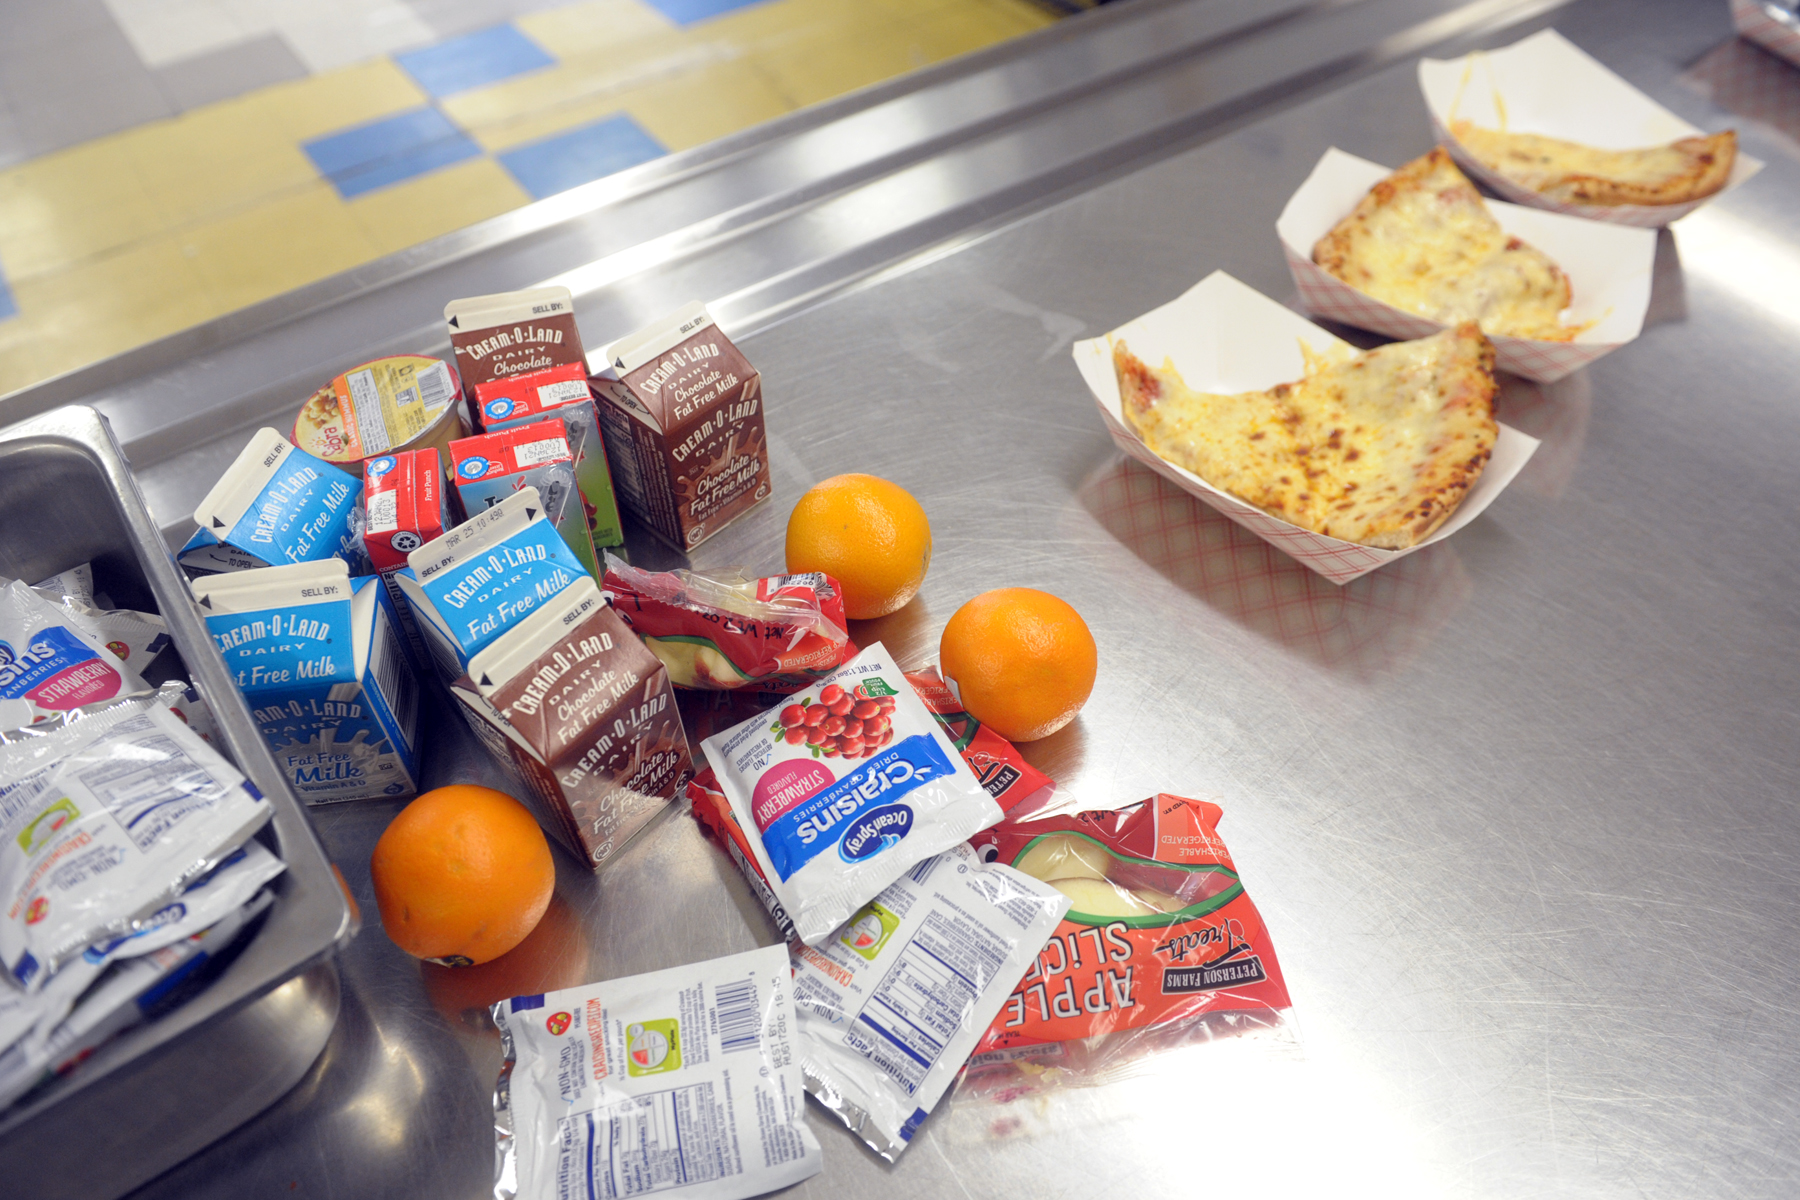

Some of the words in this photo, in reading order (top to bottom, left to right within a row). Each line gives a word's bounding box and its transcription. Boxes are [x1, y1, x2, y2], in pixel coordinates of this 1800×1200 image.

[533, 306, 548, 314] SELL
[680, 322, 694, 333] SELL
[693, 316, 705, 327] BY:
[493, 345, 546, 360] DAIRY
[494, 355, 552, 375] Chocolate
[507, 372, 532, 382] Punch
[668, 361, 709, 390] DAIRY
[674, 369, 722, 402] Chocolate
[339, 394, 353, 423] HUMMUS
[619, 394, 627, 402] TO
[624, 397, 637, 410] OPEN
[673, 399, 695, 420] Fat
[691, 388, 716, 412] Free
[716, 375, 740, 396] Milk
[322, 426, 344, 457] Sabra
[483, 429, 509, 439] Punch
[510, 425, 529, 433] Fruit
[695, 422, 744, 457] DAIRY
[263, 451, 278, 467] SELL
[274, 441, 286, 454] BY:
[690, 493, 712, 517] Fat
[709, 479, 737, 507] Free
[735, 459, 761, 486] Milk
[697, 456, 750, 496] Chocolate
[281, 490, 313, 533] DAIRY
[286, 535, 310, 564] Fat
[308, 513, 331, 542] Free
[329, 480, 350, 514] Milk
[228, 558, 236, 566] TO
[236, 559, 252, 569] OPEN
[422, 561, 441, 577] SELL
[441, 556, 455, 567] BY:
[302, 587, 322, 597] SELL
[323, 586, 338, 595] BY:
[478, 568, 532, 602] DAIRY
[467, 619, 498, 640] Fat
[497, 596, 535, 623] Free
[535, 569, 571, 601] Milk
[563, 606, 583, 625] SELL
[580, 598, 595, 613] BY:
[766, 626, 784, 639] Net
[240, 643, 306, 656] DAIRY
[251, 666, 290, 685] Free
[296, 657, 336, 680] Milk
[867, 662, 881, 671] NET
[38, 662, 111, 704] STRAWBERRY
[72, 681, 105, 700] FLAVORED
[549, 660, 601, 706] DAIRY
[557, 669, 618, 721] Chocolate
[557, 724, 583, 745] Fat
[581, 701, 611, 726] Free
[610, 671, 639, 705] Milk
[264, 720, 342, 734] DAIRY
[287, 755, 316, 767] Fat
[317, 752, 351, 764] Free
[593, 721, 654, 777] DAIRY
[295, 763, 364, 785] Milk
[751, 756, 767, 771] NO
[301, 782, 339, 792] Vitamin
[594, 809, 620, 834] Fat
[620, 781, 651, 813] Free
[649, 755, 678, 787] Milk
[600, 752, 663, 812] Chocolate
[765, 770, 798, 795] FLAVORED
[754, 768, 824, 825] STRAWBERRY
[794, 754, 915, 846] Craisins
[871, 809, 910, 831] Ocean
[843, 821, 876, 857] Spray
[972, 939, 1004, 965] INGREDIENTS:
[1152, 917, 1252, 969] Treats
[1165, 972, 1201, 986] FARMS
[1202, 962, 1257, 983] PETERSON
[849, 982, 863, 994] Visit
[912, 981, 949, 1011] Carbohydrate
[955, 978, 979, 998] Protein
[1005, 965, 1135, 1027] APPLE
[790, 986, 835, 1021] NON-GMO
[946, 1008, 962, 1022] Total
[923, 1014, 936, 1025] Fat
[933, 1009, 957, 1030] Sodium
[934, 1022, 952, 1037] Total
[770, 1042, 782, 1068] BEST
[844, 1031, 873, 1058] Facts
[916, 1034, 940, 1055] Calories
[561, 1046, 571, 1095] NON-GMO
[872, 1054, 917, 1093] Nutrition
